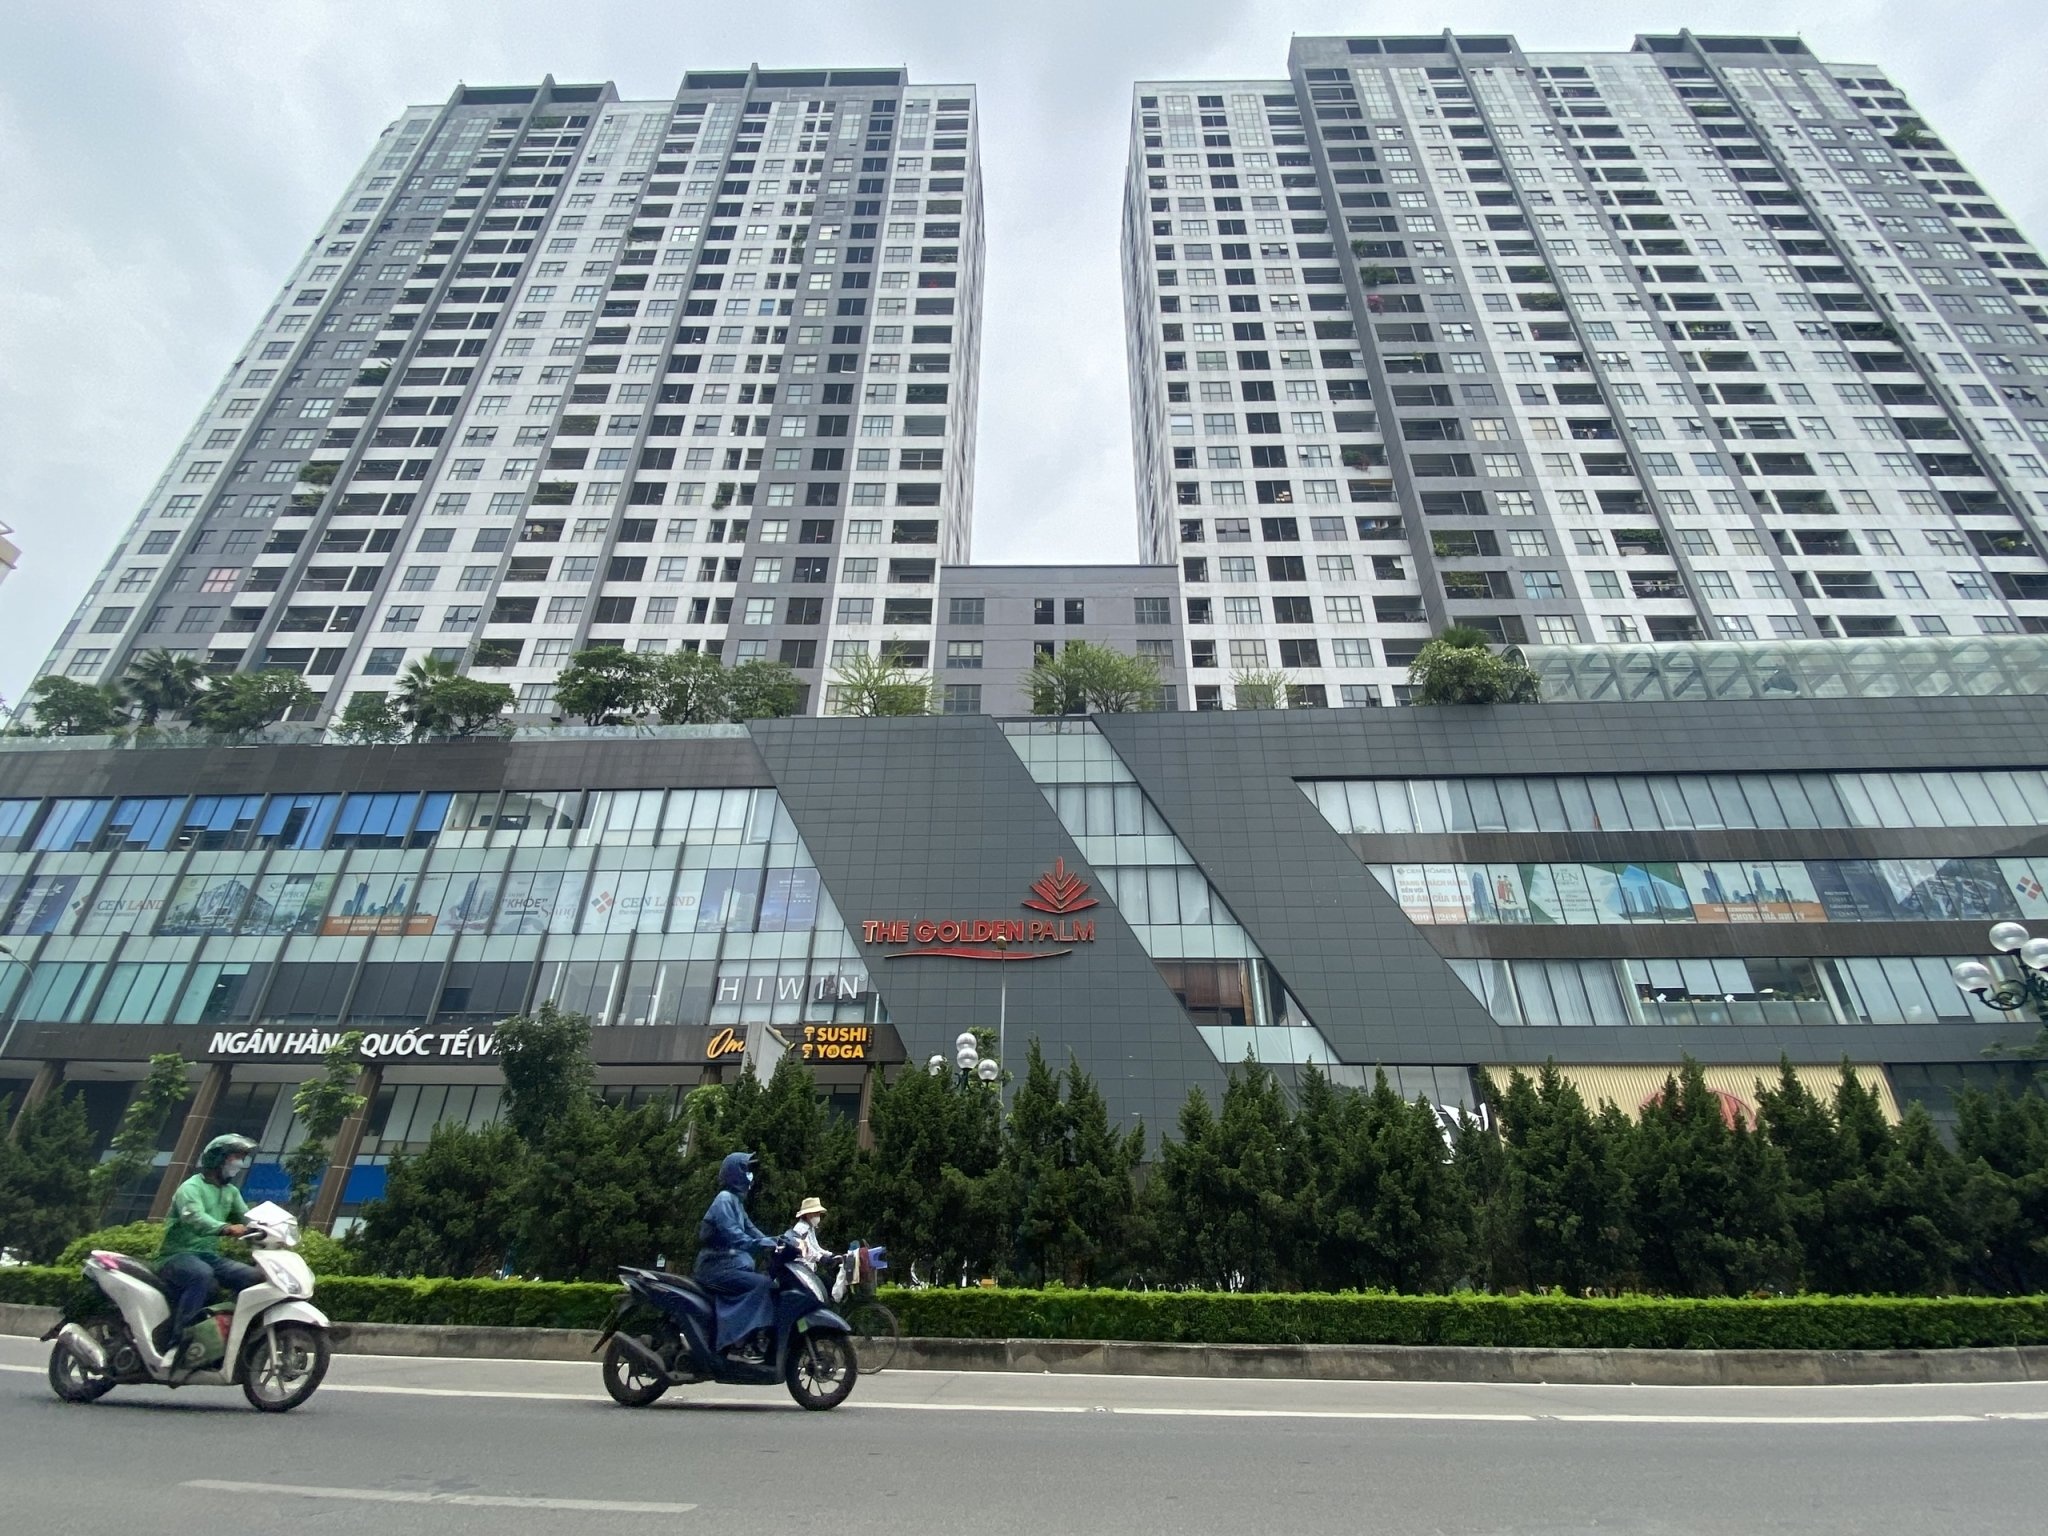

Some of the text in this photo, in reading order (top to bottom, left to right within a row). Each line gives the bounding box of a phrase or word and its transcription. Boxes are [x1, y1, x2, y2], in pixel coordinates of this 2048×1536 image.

[97, 899, 126, 911] CEN
[620, 896, 652, 909] CEN
[862, 919, 1095, 943] THE GOLDEN PALM
[718, 976, 860, 1001] HIWIN
[816, 1027, 867, 1042] SUSHI
[208, 1029, 282, 1054] NGÂN
[283, 1028, 348, 1055] HÀN
[360, 1027, 435, 1058] QUỐC
[816, 1044, 865, 1059] YOGA
